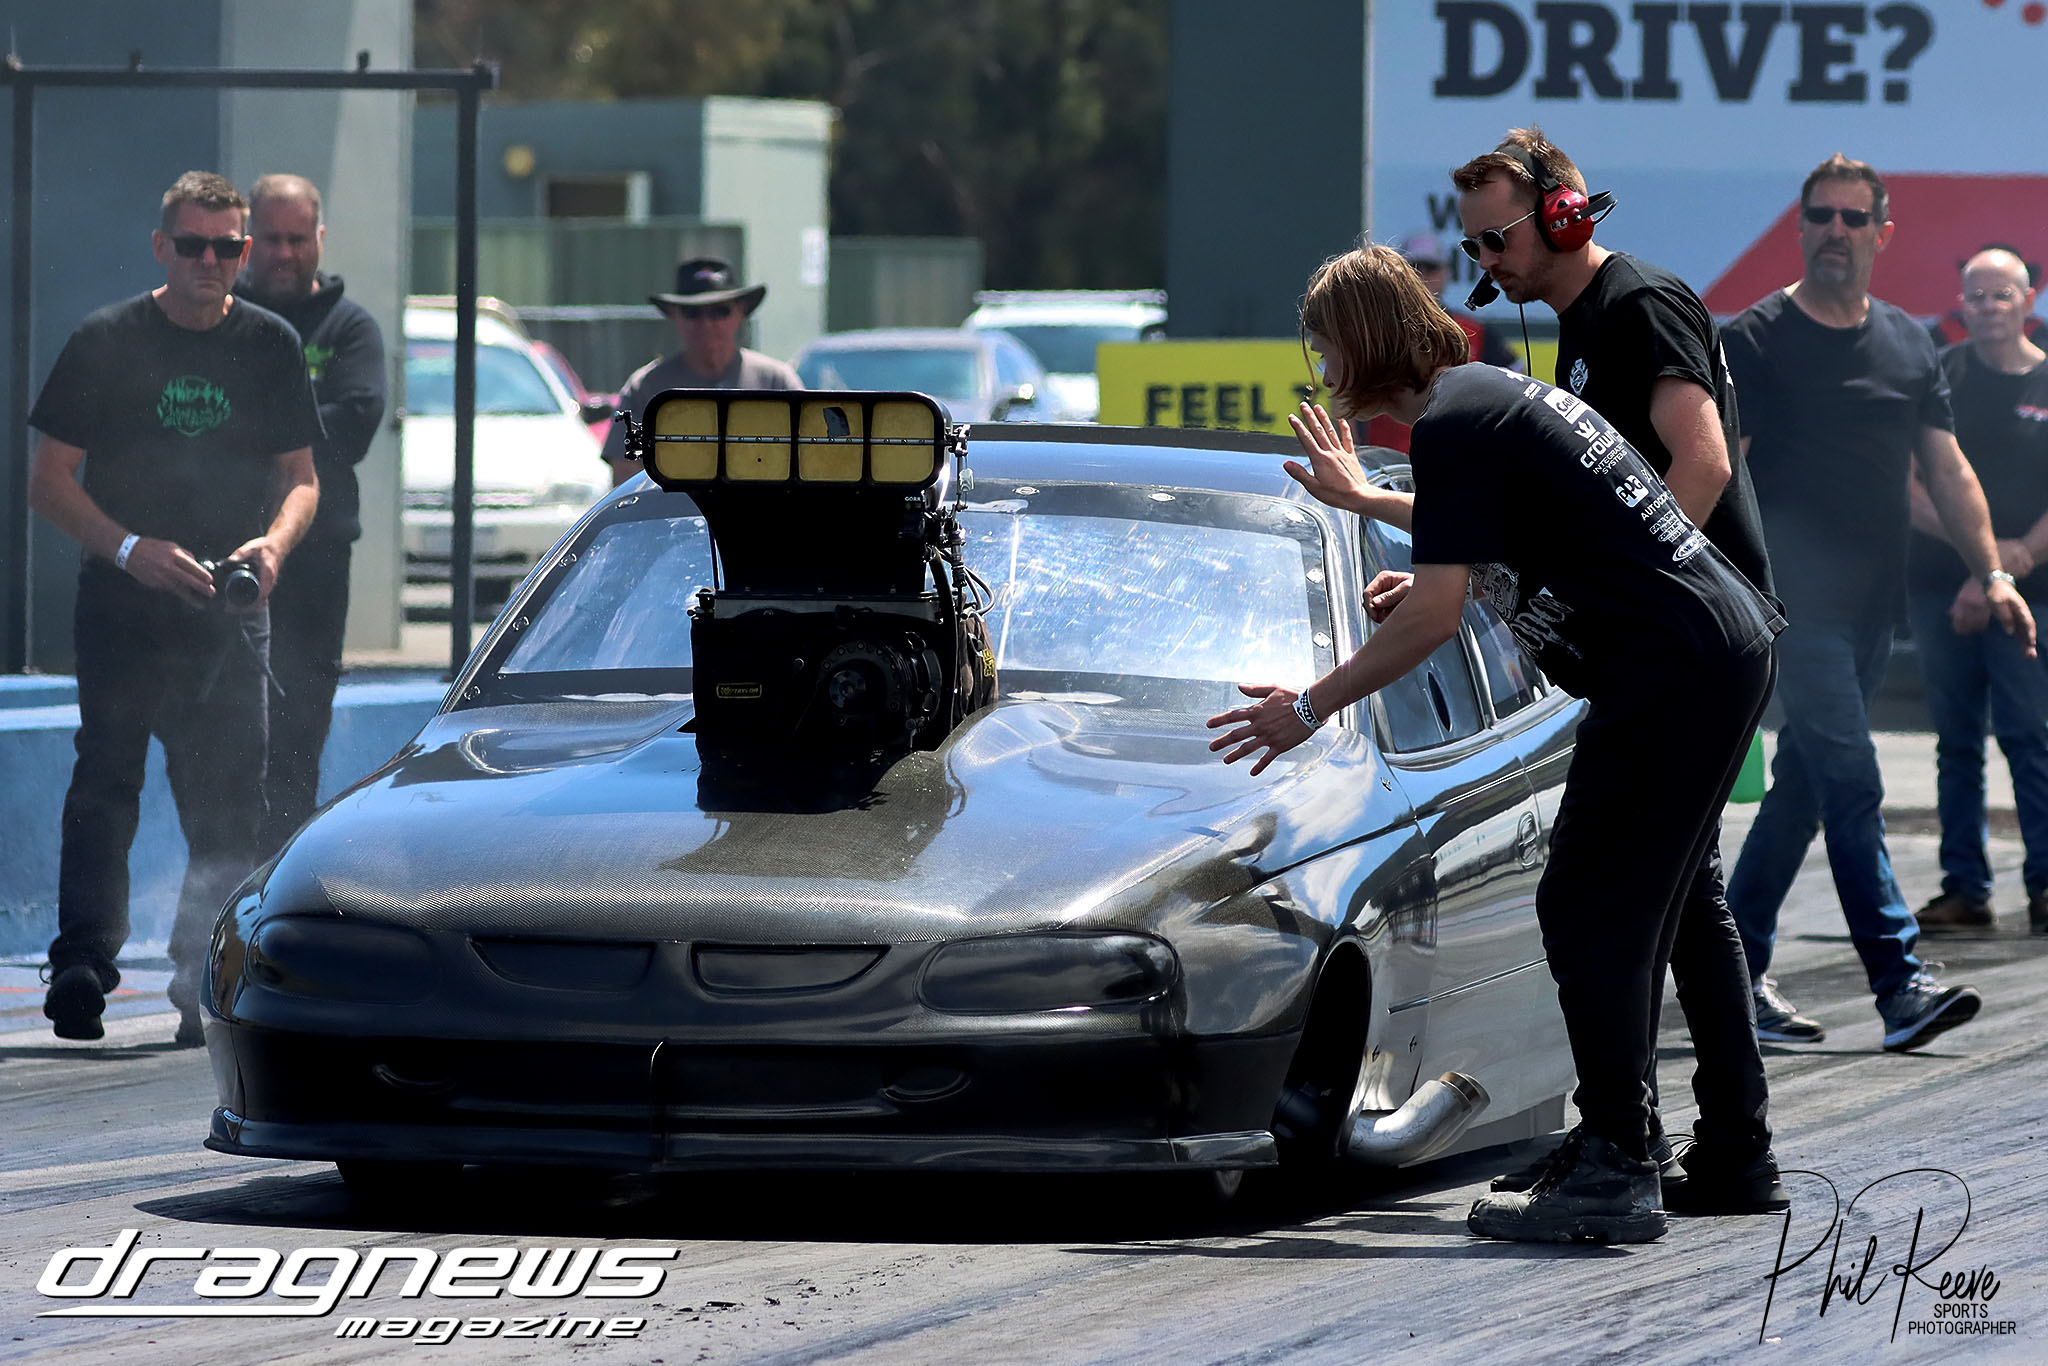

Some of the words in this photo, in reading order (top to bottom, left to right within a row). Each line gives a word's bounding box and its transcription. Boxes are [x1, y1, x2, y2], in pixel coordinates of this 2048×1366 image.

[1434, 2, 1934, 103] DRIVE?
[1146, 383, 1276, 425] FEEL
[1618, 477, 1644, 504] PPG
